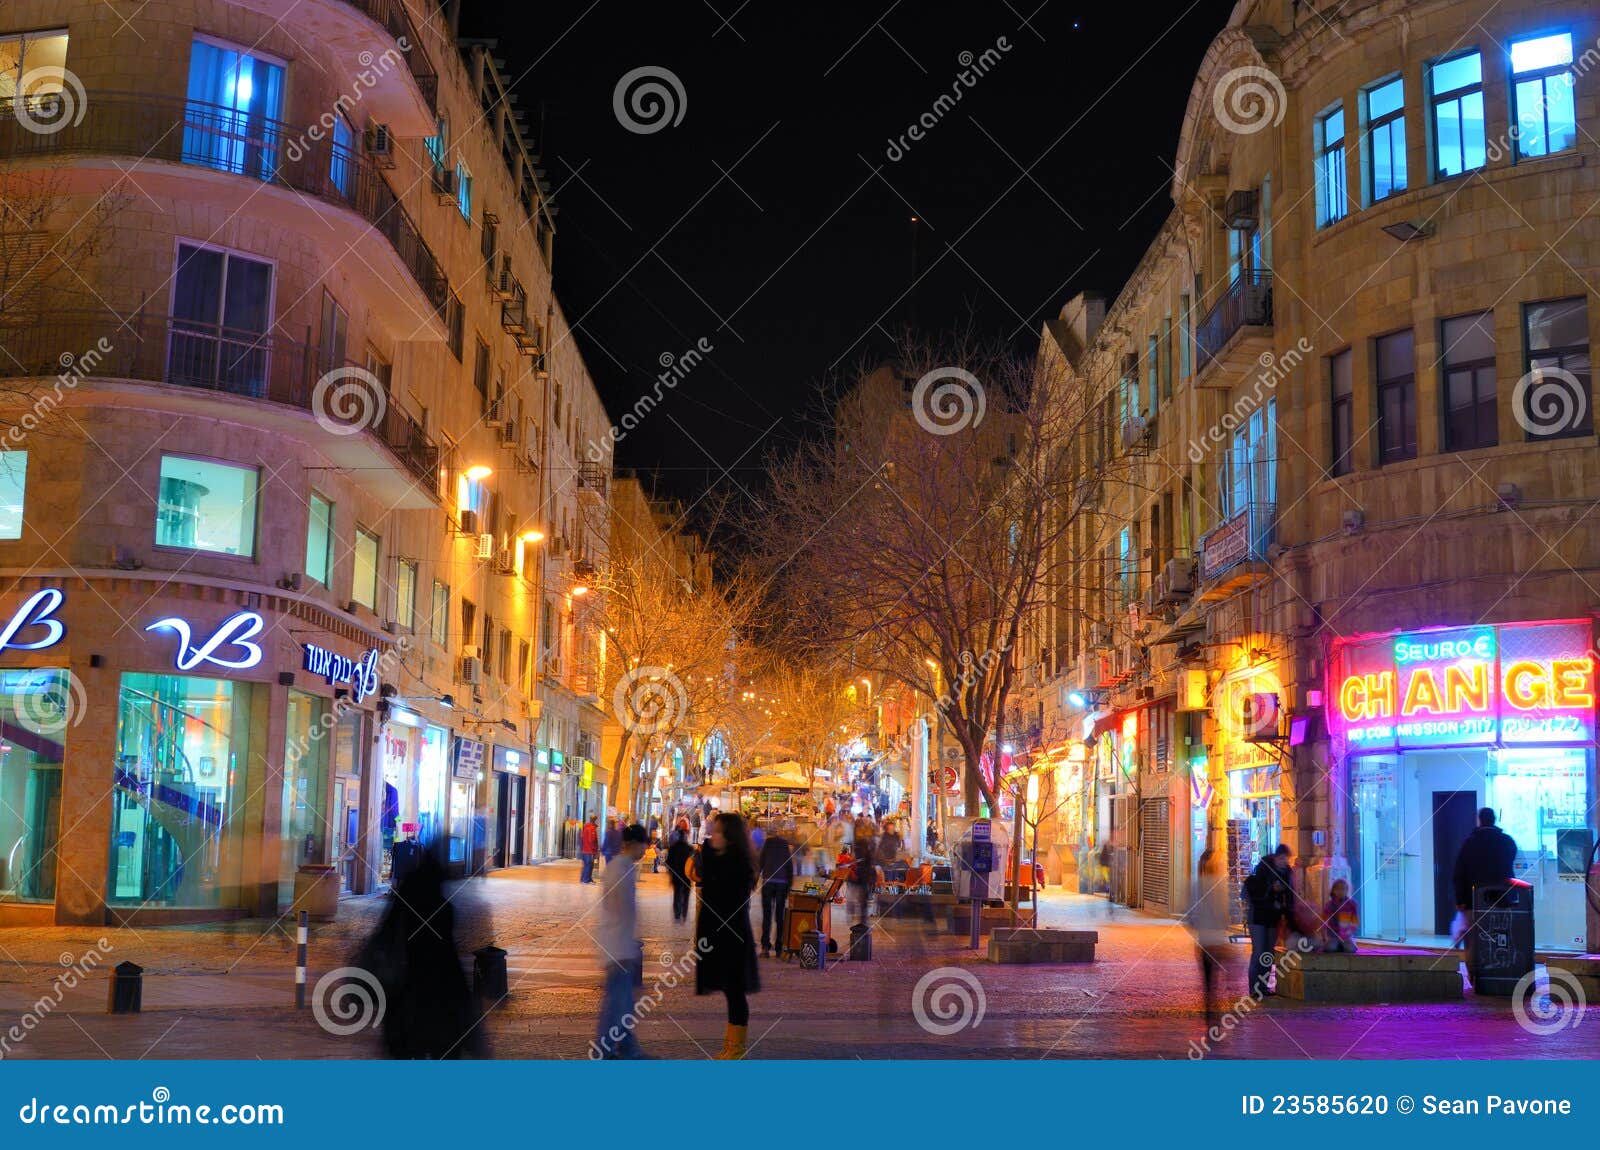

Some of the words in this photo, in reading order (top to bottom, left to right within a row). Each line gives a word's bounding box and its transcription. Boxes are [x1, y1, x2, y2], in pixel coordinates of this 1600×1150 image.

[307, 643, 333, 677] אגוד
[331, 654, 352, 686] בנק
[1340, 657, 1594, 722] CHANGE
